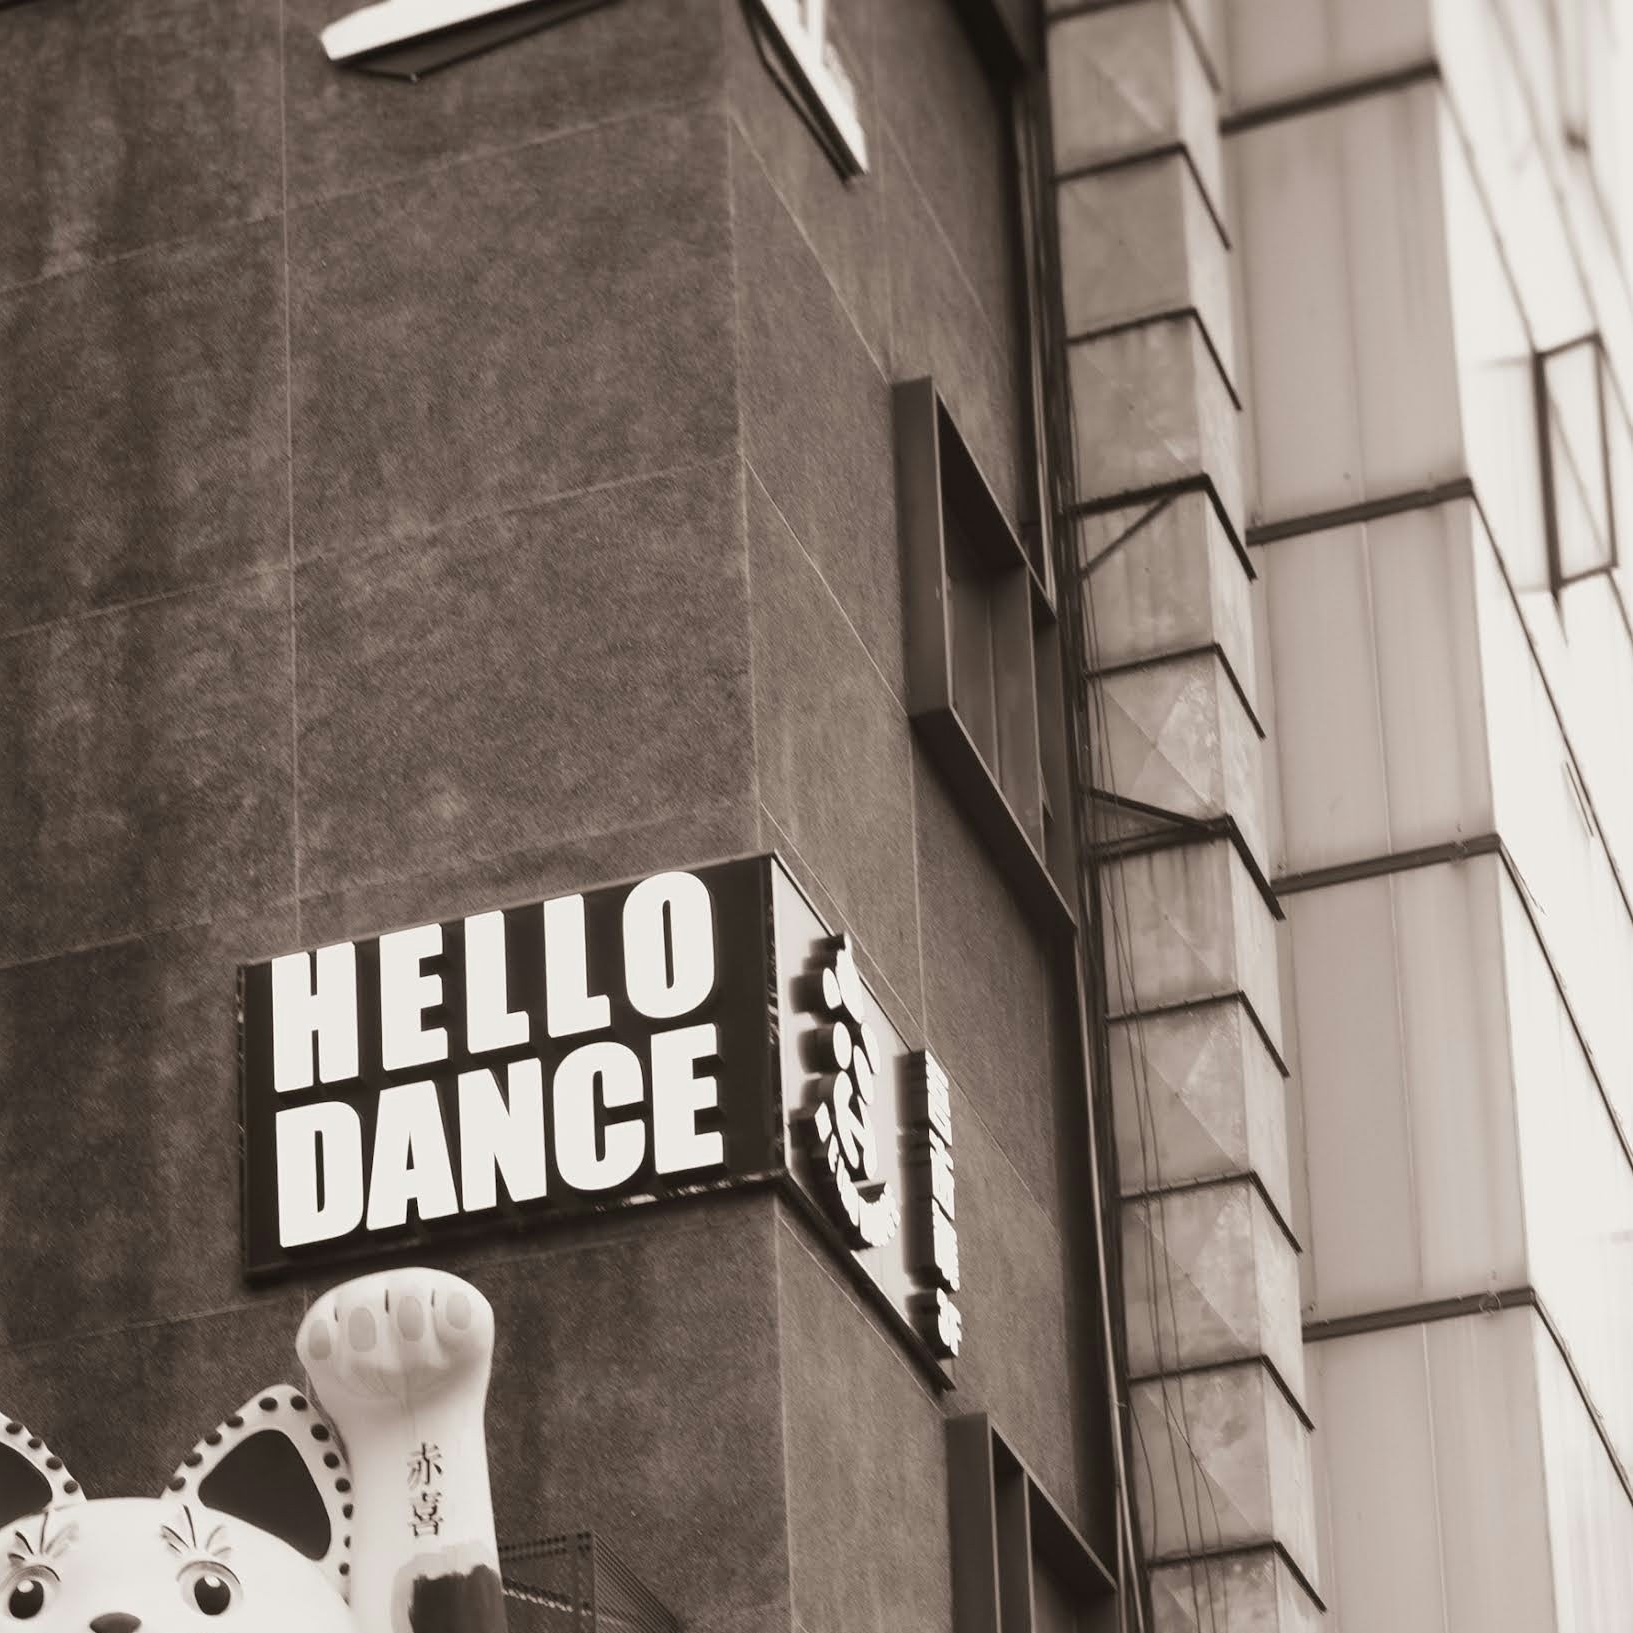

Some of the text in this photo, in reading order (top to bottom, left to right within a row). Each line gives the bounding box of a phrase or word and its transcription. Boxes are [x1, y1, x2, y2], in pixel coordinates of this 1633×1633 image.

[271, 871, 715, 1093] HELLO
[275, 1023, 724, 1247] DANCE
[406, 1441, 445, 1538] 赤喜
